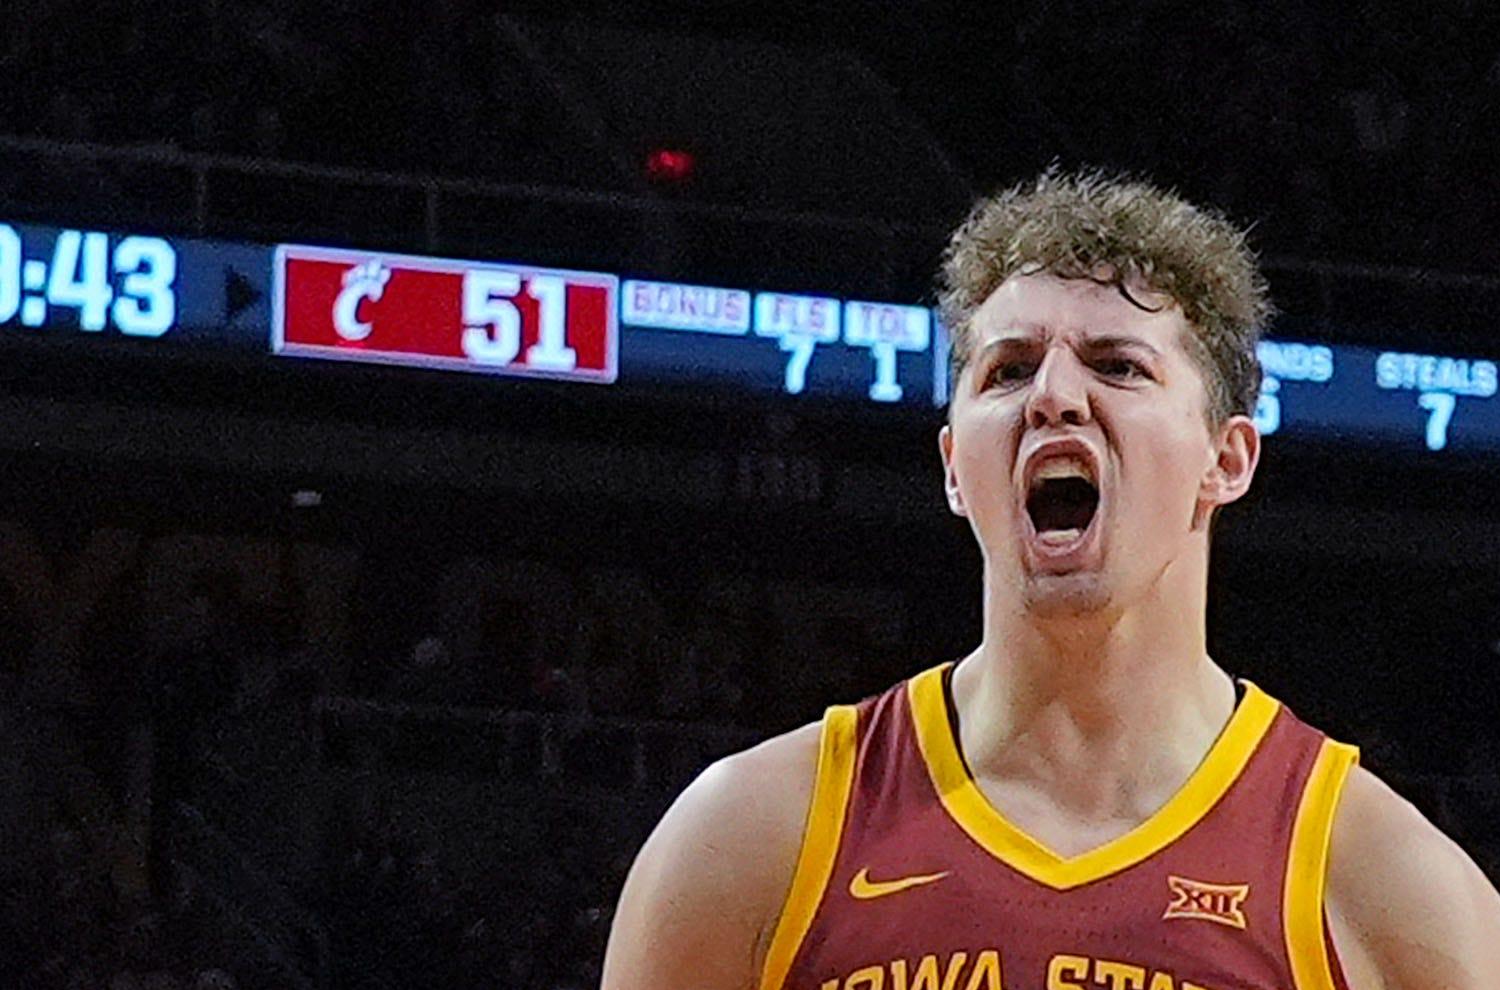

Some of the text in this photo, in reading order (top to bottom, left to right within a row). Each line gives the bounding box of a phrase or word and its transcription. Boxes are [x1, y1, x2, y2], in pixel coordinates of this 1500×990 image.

[461, 269, 577, 372] 51
[778, 334, 816, 394] 7
[869, 342, 904, 402] 1
[1255, 340, 1334, 382] NDS
[1375, 352, 1498, 397] STEALS
[1417, 393, 1456, 450] 7
